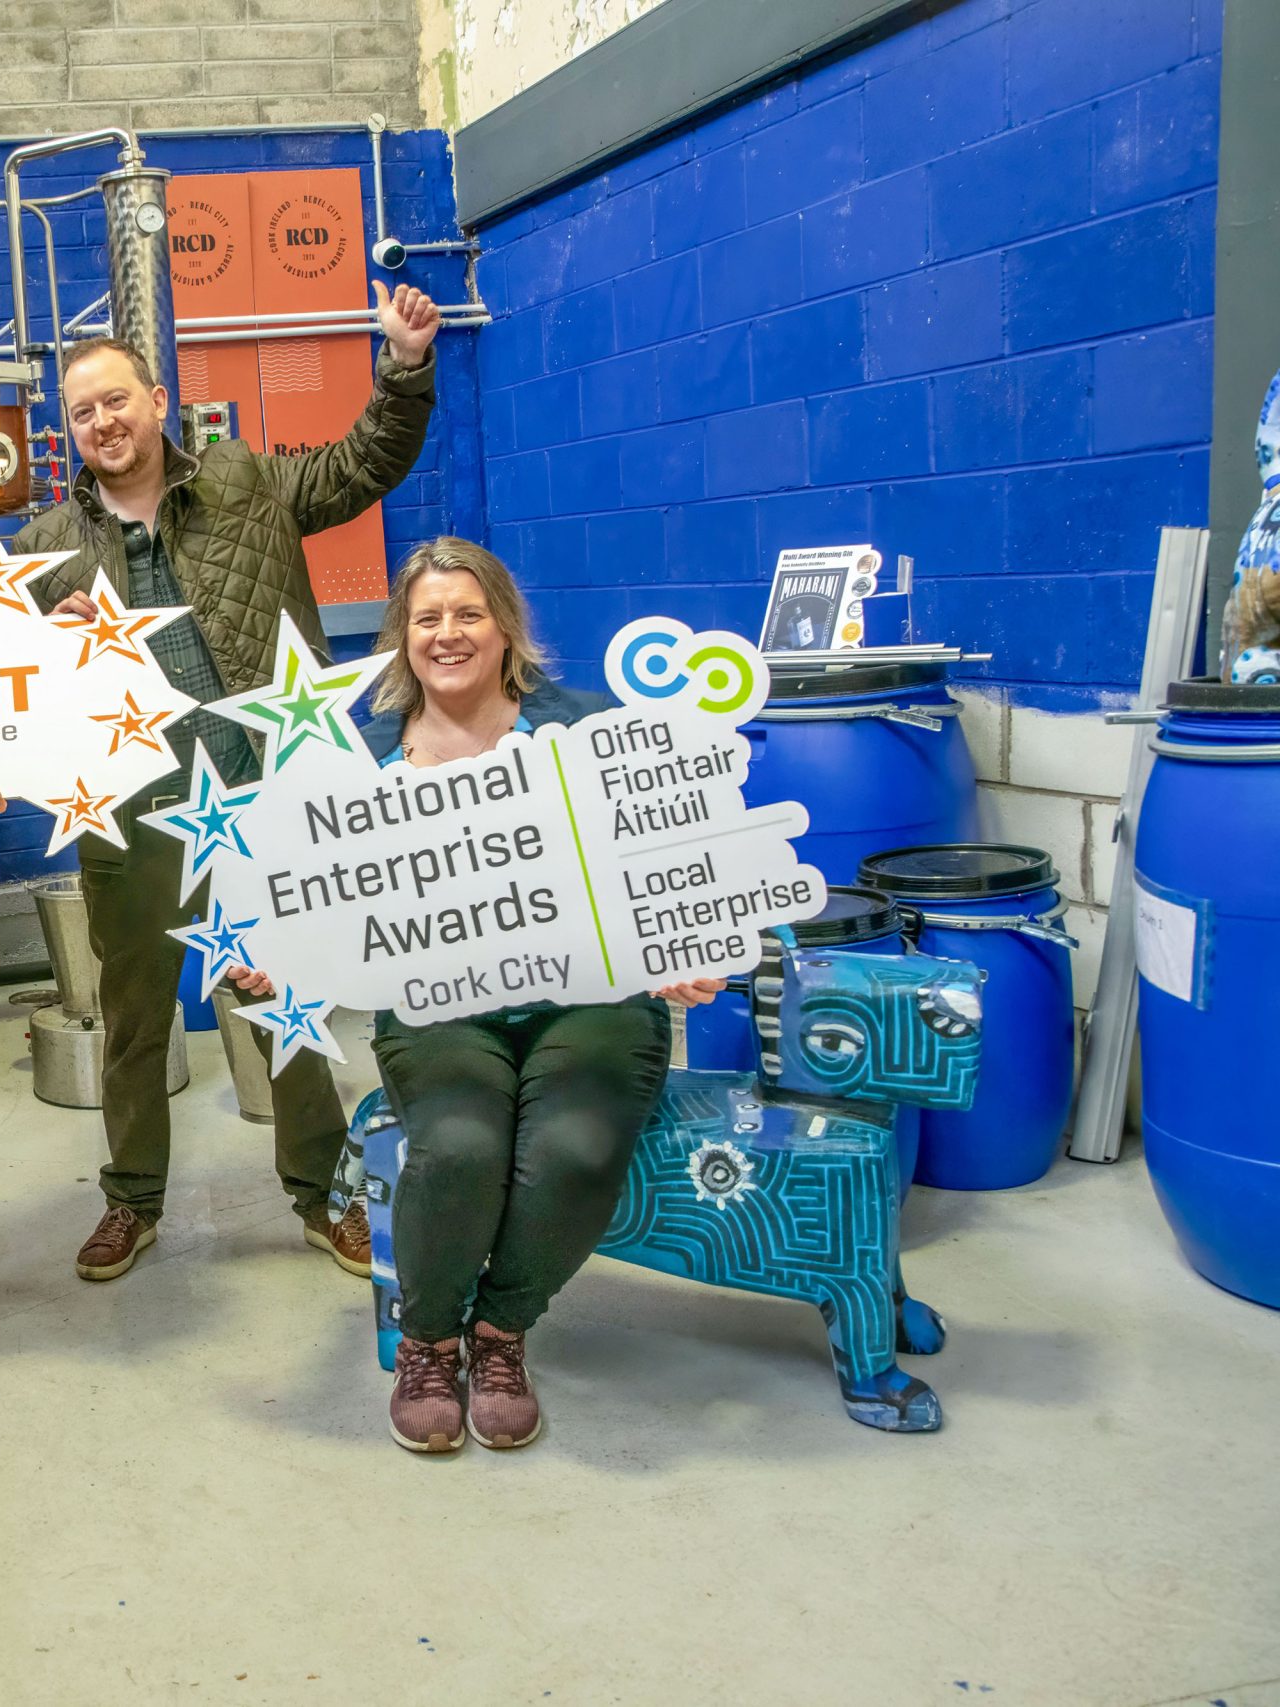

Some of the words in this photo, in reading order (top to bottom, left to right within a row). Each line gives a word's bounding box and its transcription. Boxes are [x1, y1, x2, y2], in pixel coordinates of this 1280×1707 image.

[172, 233, 216, 253] RCD
[286, 227, 329, 246] RCD
[273, 440, 330, 458] Reb
[780, 575, 840, 602] MAHARANI
[590, 719, 674, 759] Oifig
[304, 747, 529, 844] National
[600, 744, 735, 799] Fiontair
[613, 789, 709, 840] Áitiúil
[267, 824, 543, 918] Enterprise
[623, 852, 716, 900] Local
[363, 881, 559, 962] Awards
[632, 879, 812, 939] Enterprise
[642, 933, 746, 975] Office
[403, 966, 492, 1011] Cork
[498, 954, 570, 991] City
